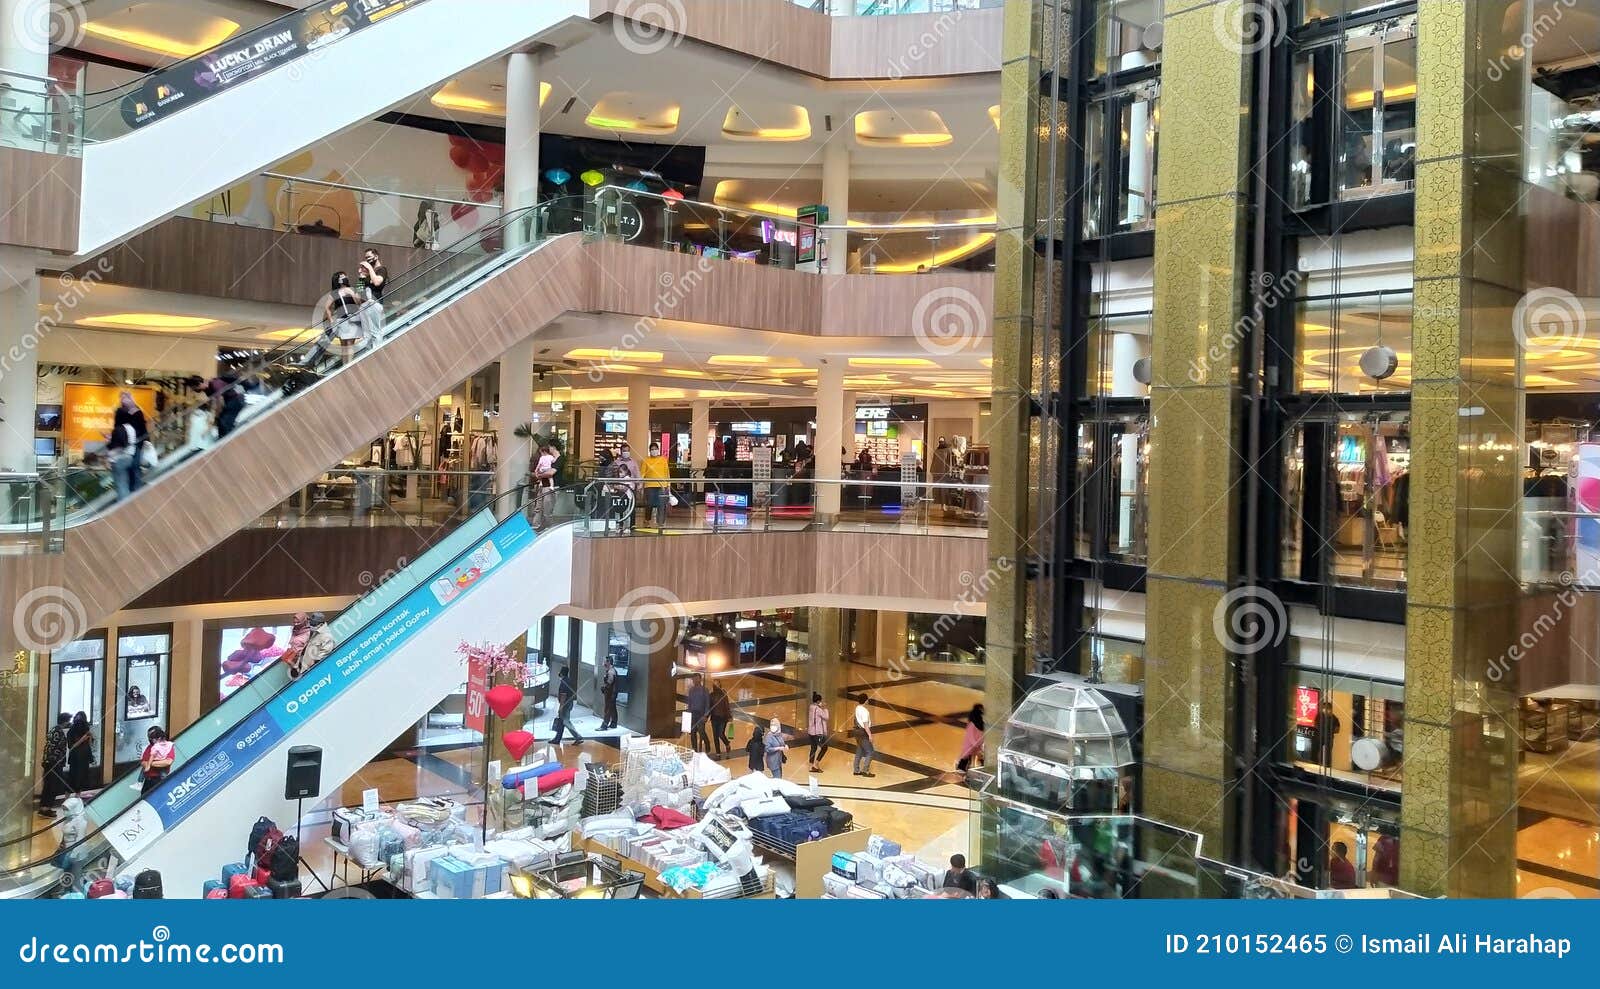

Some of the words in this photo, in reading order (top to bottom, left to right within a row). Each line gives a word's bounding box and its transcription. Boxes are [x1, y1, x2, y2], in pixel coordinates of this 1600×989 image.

[208, 48, 251, 74] LUCKY
[254, 30, 293, 54] DRAW
[335, 647, 360, 668] Bayar
[359, 630, 384, 650] tanpa
[382, 608, 411, 632] kontak
[341, 659, 363, 678] lebih
[362, 642, 386, 662] aman
[384, 627, 406, 646] pakai
[405, 607, 431, 629] GoPay
[298, 673, 333, 705] gopay
[244, 723, 268, 745] gojek
[165, 777, 198, 806] J3K
